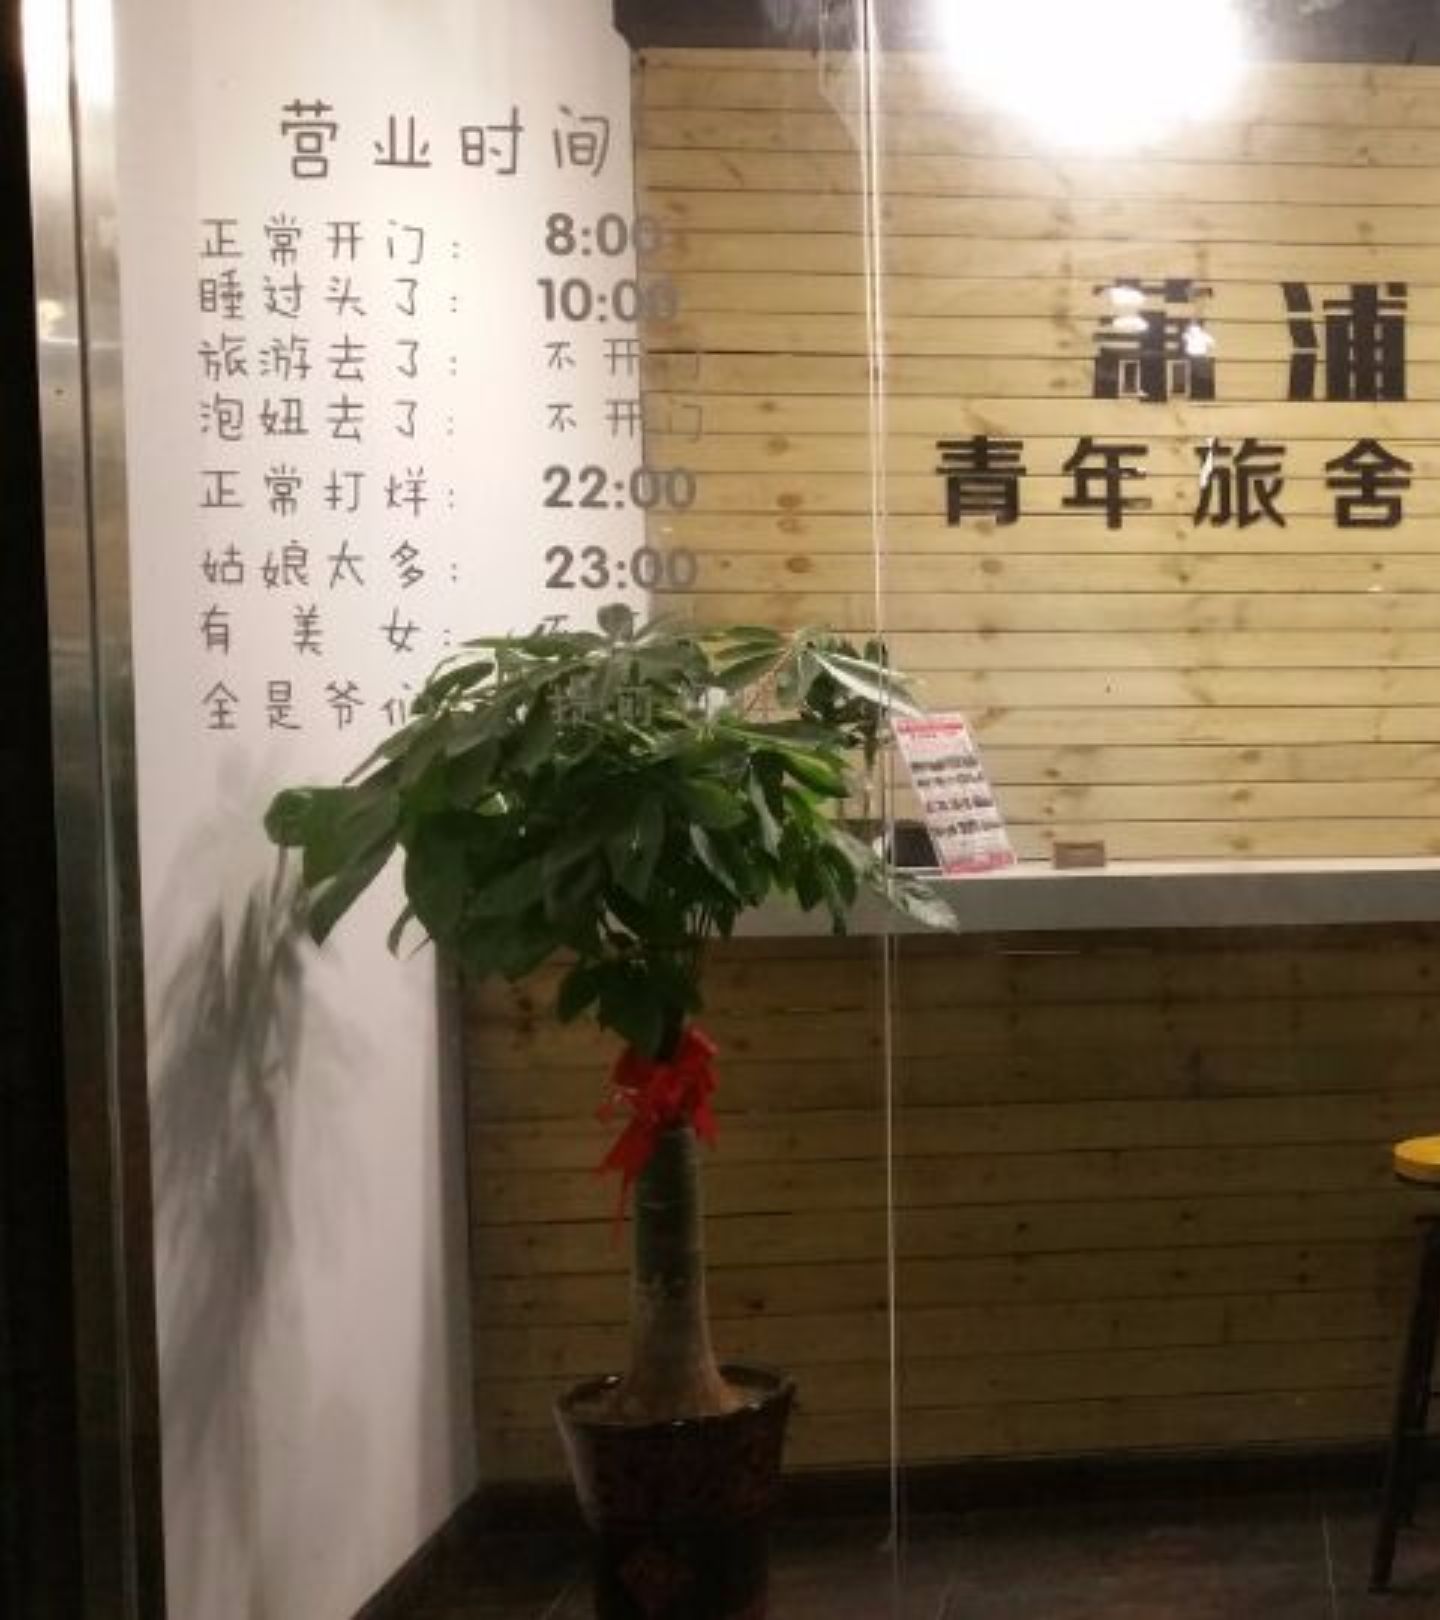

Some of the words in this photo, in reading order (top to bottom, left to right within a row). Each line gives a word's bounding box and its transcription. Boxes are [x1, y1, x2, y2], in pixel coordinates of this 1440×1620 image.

[280, 99, 610, 179] 营业时间
[544, 211, 662, 257] 8:00
[536, 277, 681, 323] 10:00
[542, 464, 699, 511] 22:00
[935, 434, 1414, 529] 青年旅舍
[544, 544, 699, 591] 23:00
